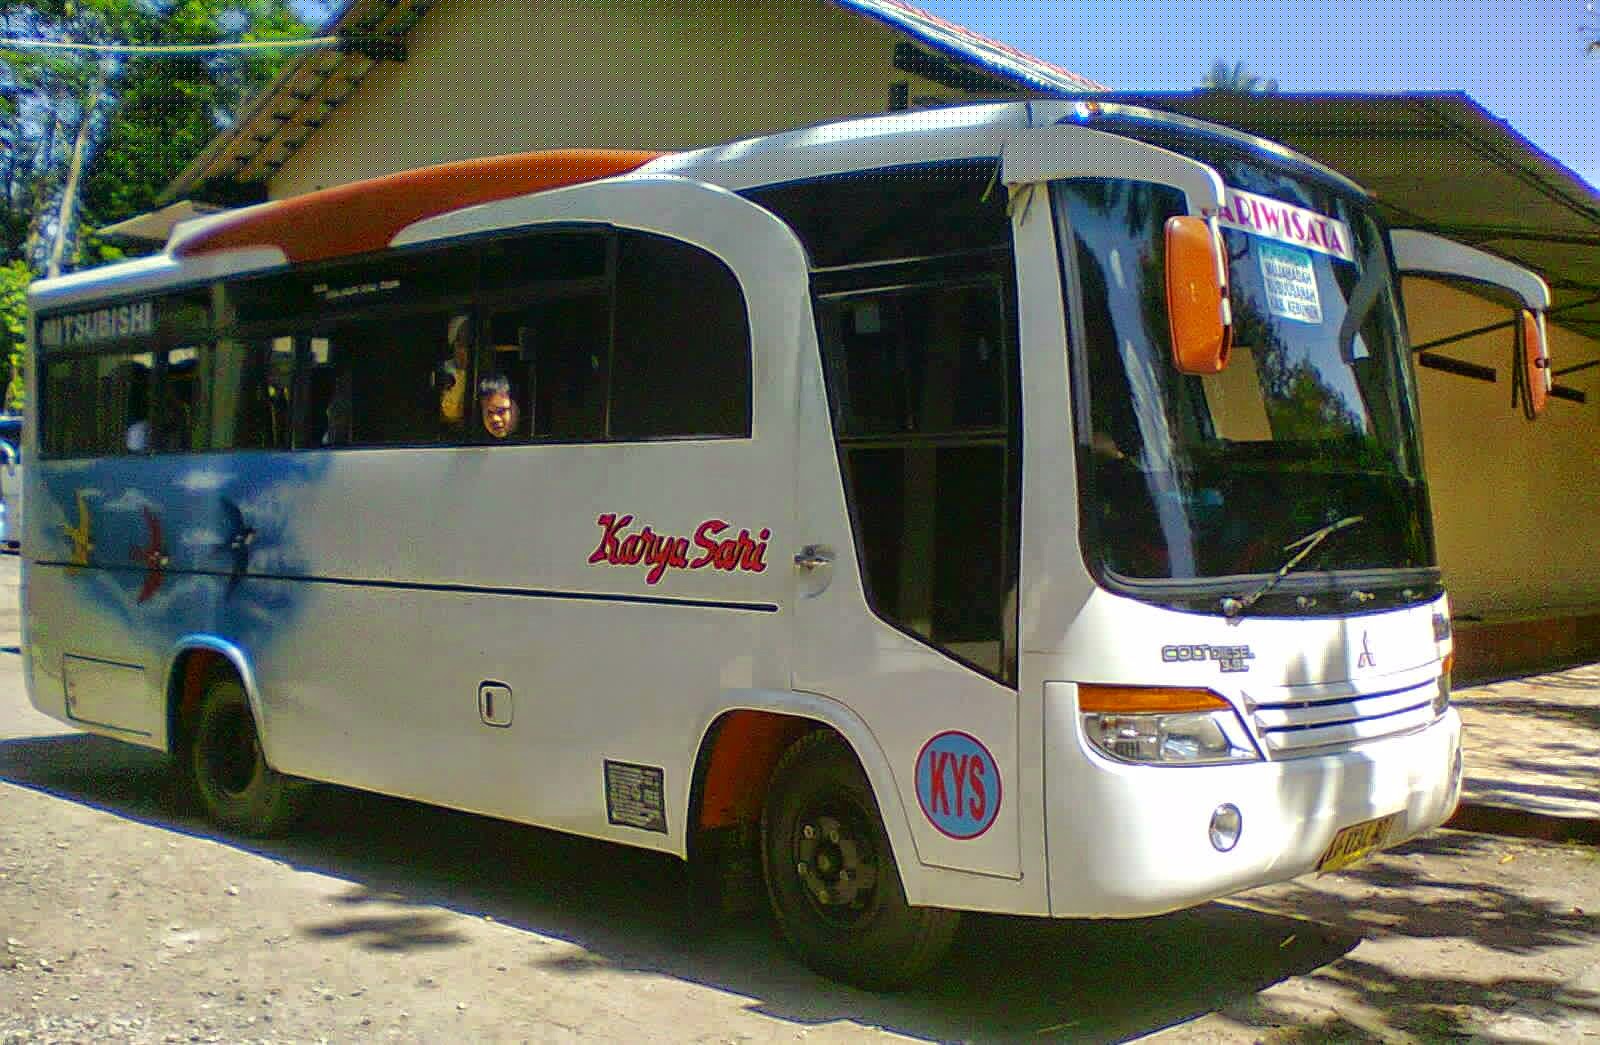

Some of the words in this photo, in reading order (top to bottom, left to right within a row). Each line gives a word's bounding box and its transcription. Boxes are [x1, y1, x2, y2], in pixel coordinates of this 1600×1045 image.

[1218, 194, 1345, 255] ARIWISATA
[42, 302, 152, 346] MITSUBISHI
[587, 512, 690, 585] Karya
[689, 519, 772, 573] Sari
[929, 750, 986, 822] KYS
